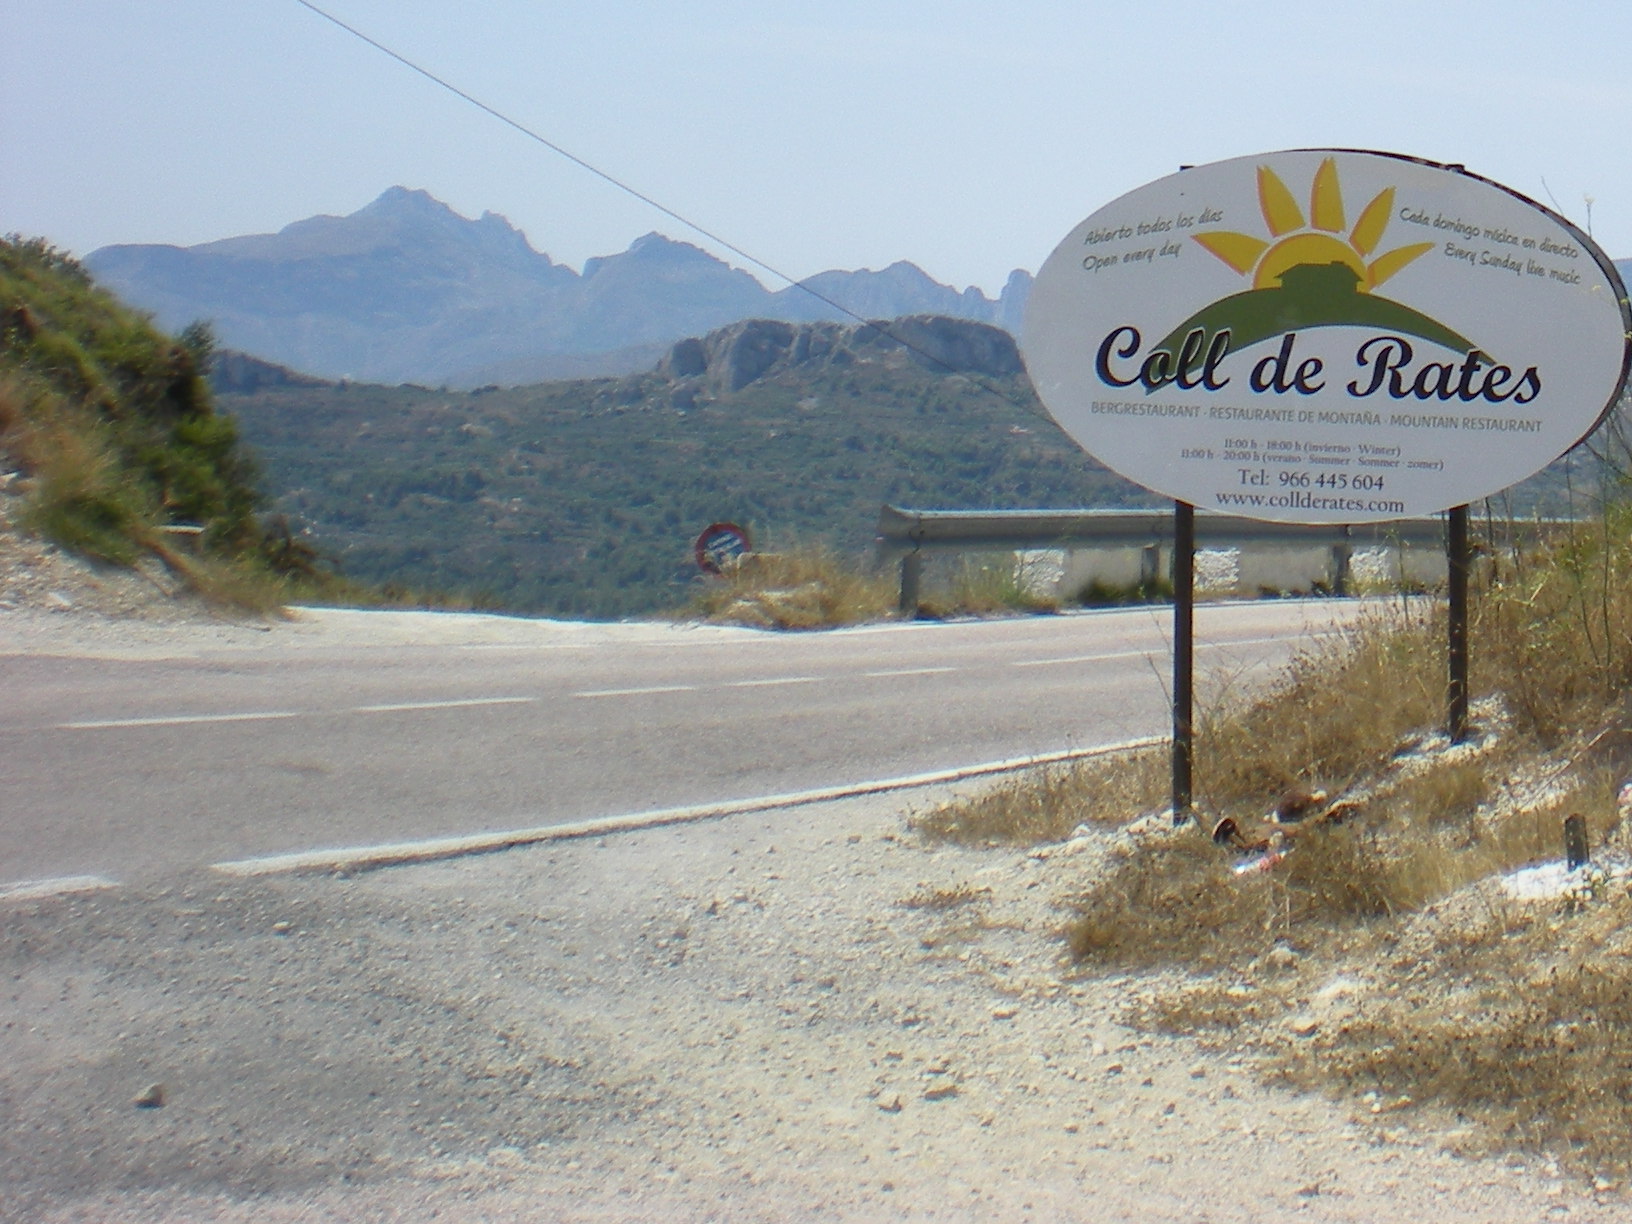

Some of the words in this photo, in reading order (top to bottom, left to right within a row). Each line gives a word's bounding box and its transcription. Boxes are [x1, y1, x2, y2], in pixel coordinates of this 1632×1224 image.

[1083, 225, 1133, 245] Abierto
[1137, 216, 1173, 236] todos
[1177, 211, 1195, 228] los
[1400, 207, 1430, 226] Cada
[1433, 213, 1480, 240] domingo
[1521, 237, 1536, 249] en
[1539, 237, 1579, 258] directo
[1083, 254, 1118, 274] Open
[1123, 247, 1155, 263] every
[1159, 240, 1182, 258] day
[1444, 242, 1477, 265] Every
[1480, 250, 1523, 276] Sunday
[1526, 258, 1545, 277] live
[1549, 269, 1581, 285] music
[1095, 325, 1232, 391] Coll
[1250, 333, 1326, 395] de
[1347, 335, 1541, 405] Rates
[1091, 401, 1200, 418] BERGRESTAURANT
[1209, 407, 1295, 423] RESTAURANTE
[1298, 410, 1315, 423] DE
[1318, 410, 1381, 426] MONTAÑA
[1390, 414, 1459, 430] MOUNTAIN
[1462, 418, 1543, 433] RESTAURANT
[1238, 468, 1270, 487] Tel:
[1279, 470, 1310, 487] 966
[1315, 473, 1348, 490] 445
[1352, 474, 1385, 491] 604
[1215, 490, 1404, 513] www.collderates.com
